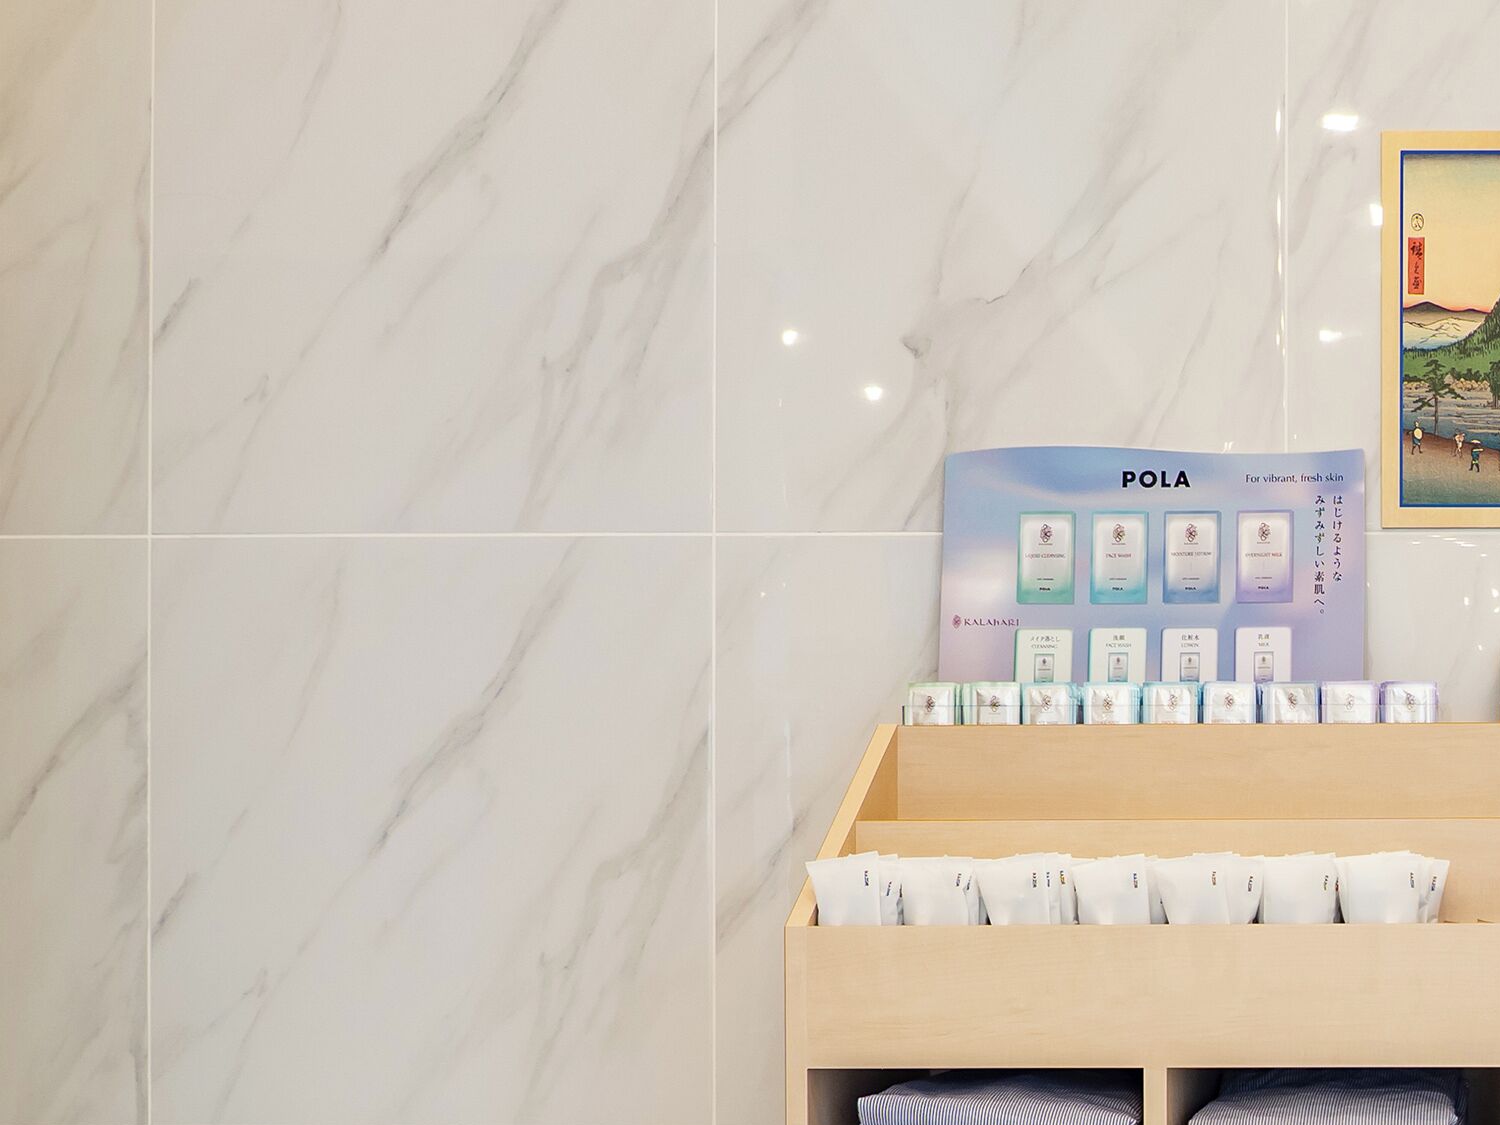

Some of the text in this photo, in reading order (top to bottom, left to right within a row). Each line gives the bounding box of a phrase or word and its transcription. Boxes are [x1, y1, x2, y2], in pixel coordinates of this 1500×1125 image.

[1121, 470, 1191, 488] POLA
[1245, 472, 1344, 484] For vibrant, fresh skin
[1332, 495, 1343, 582] はじけるような
[1313, 495, 1326, 615] みずみずしい素肌へ。
[964, 618, 1020, 626] KALAHARI
